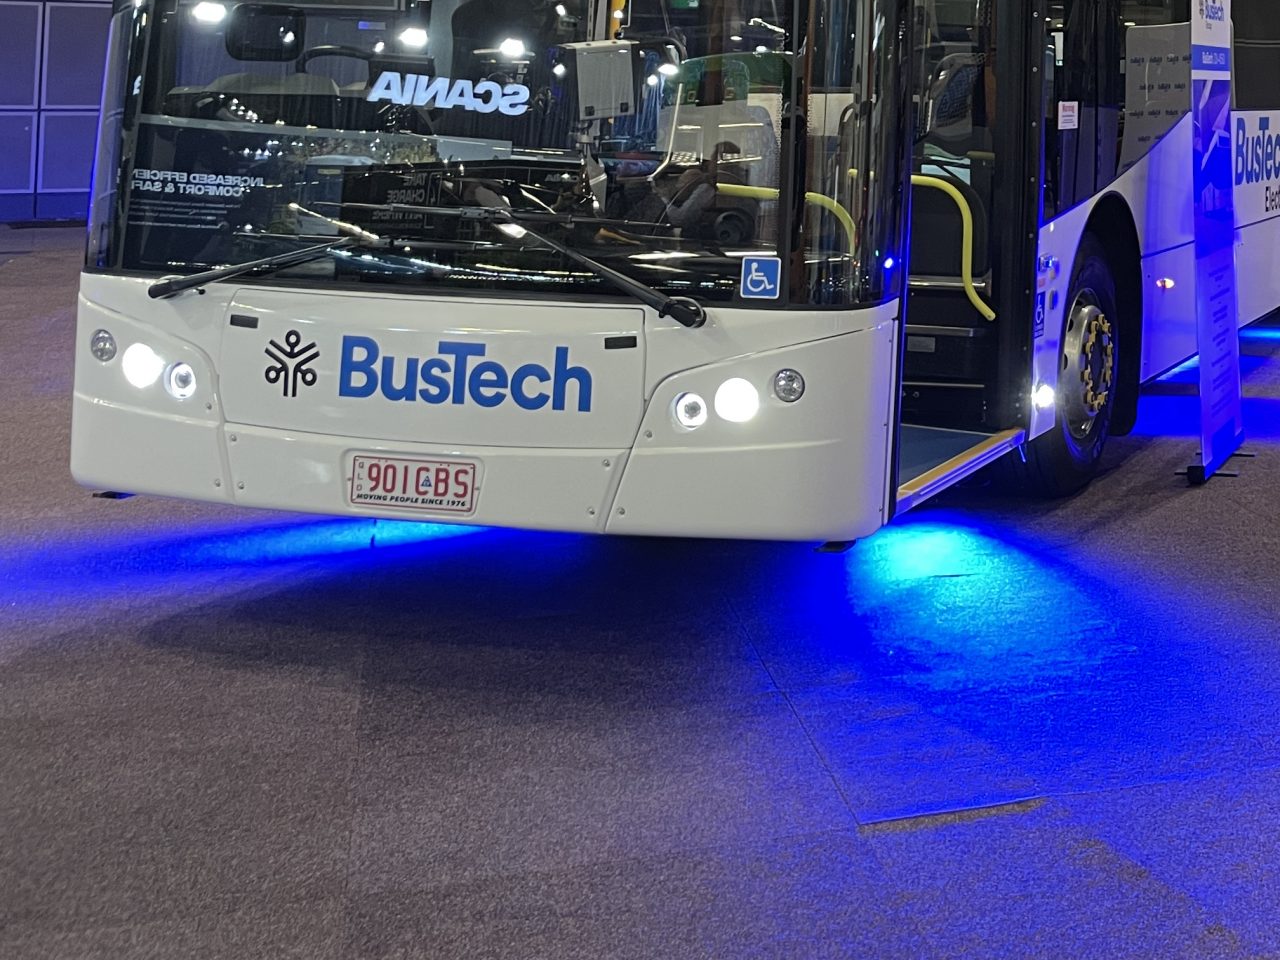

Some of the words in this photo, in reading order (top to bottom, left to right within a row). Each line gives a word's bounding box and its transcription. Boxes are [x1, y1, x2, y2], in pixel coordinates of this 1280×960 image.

[338, 334, 593, 413] BusTech
[356, 493, 388, 501] MOVING
[390, 495, 419, 504] PEOPLE
[420, 497, 444, 506] SINCE
[446, 499, 466, 507] 1976
